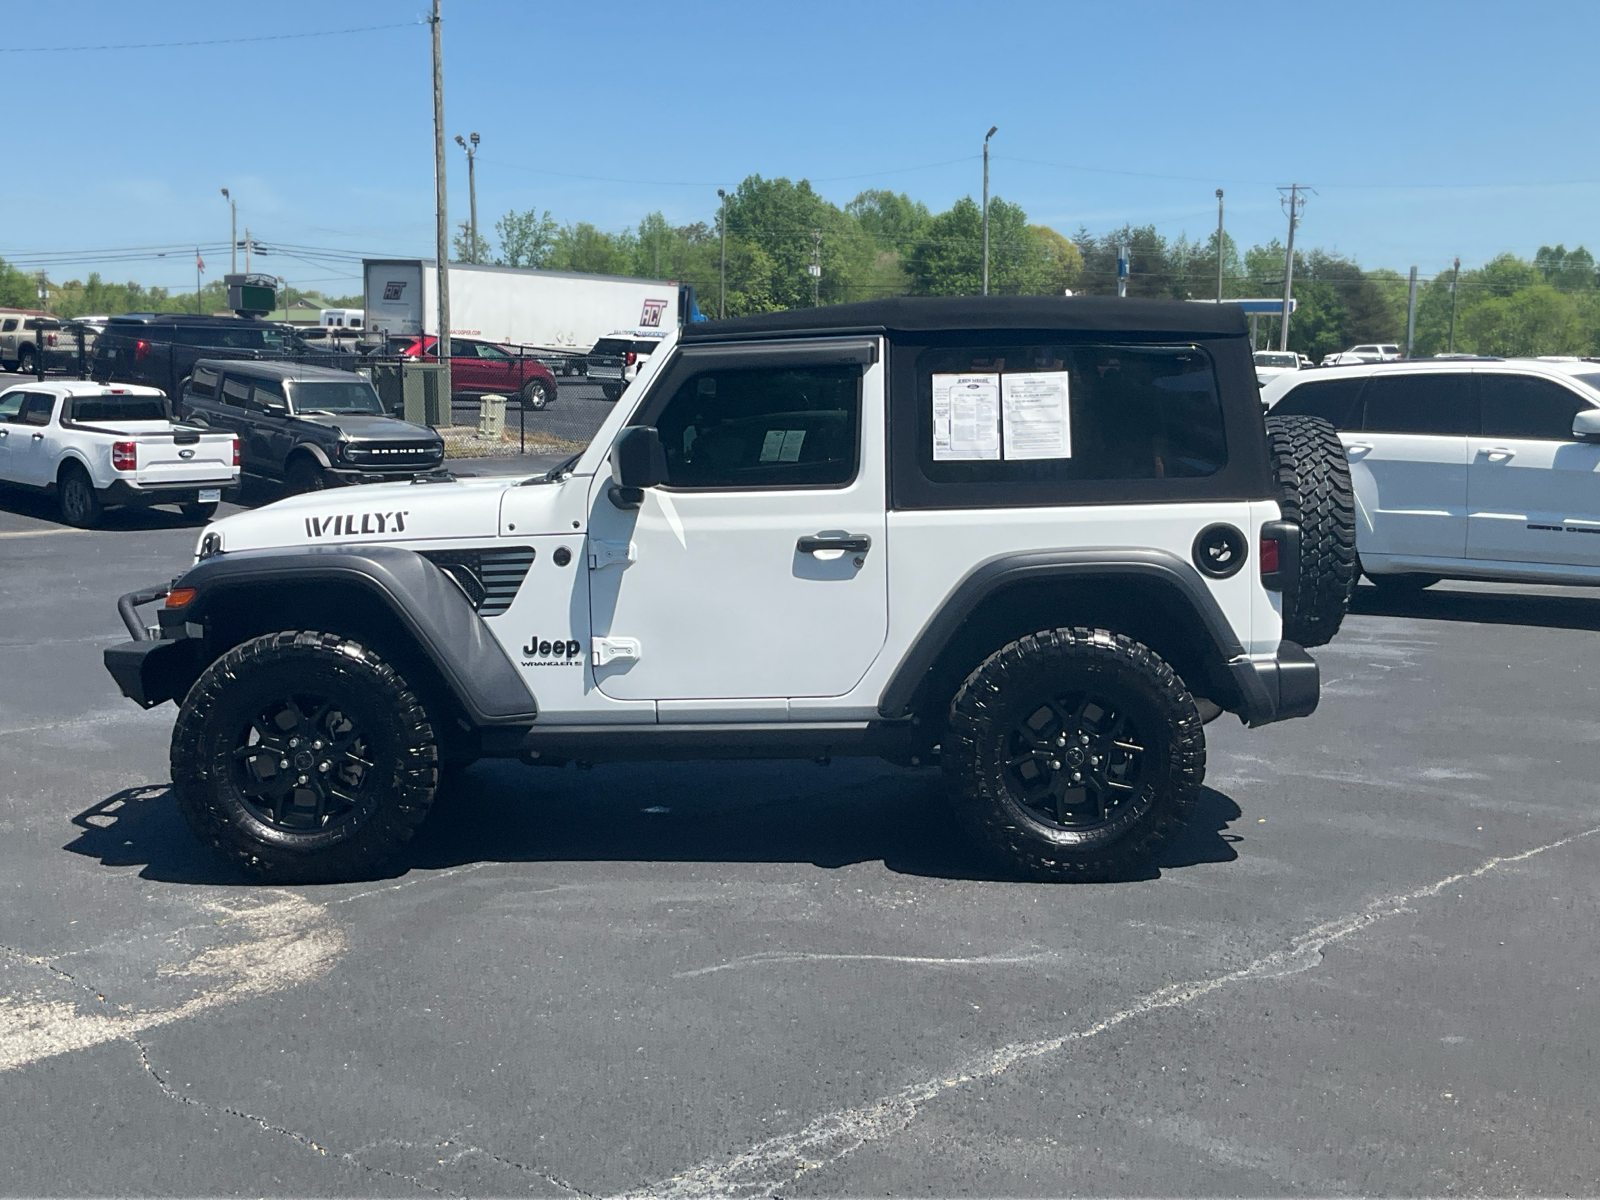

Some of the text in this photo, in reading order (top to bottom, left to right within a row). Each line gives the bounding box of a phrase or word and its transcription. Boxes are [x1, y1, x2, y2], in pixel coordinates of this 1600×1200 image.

[383, 281, 407, 300] ACT
[639, 299, 668, 327] ACT
[305, 511, 408, 537] WILLYS
[523, 636, 580, 658] Jeep
